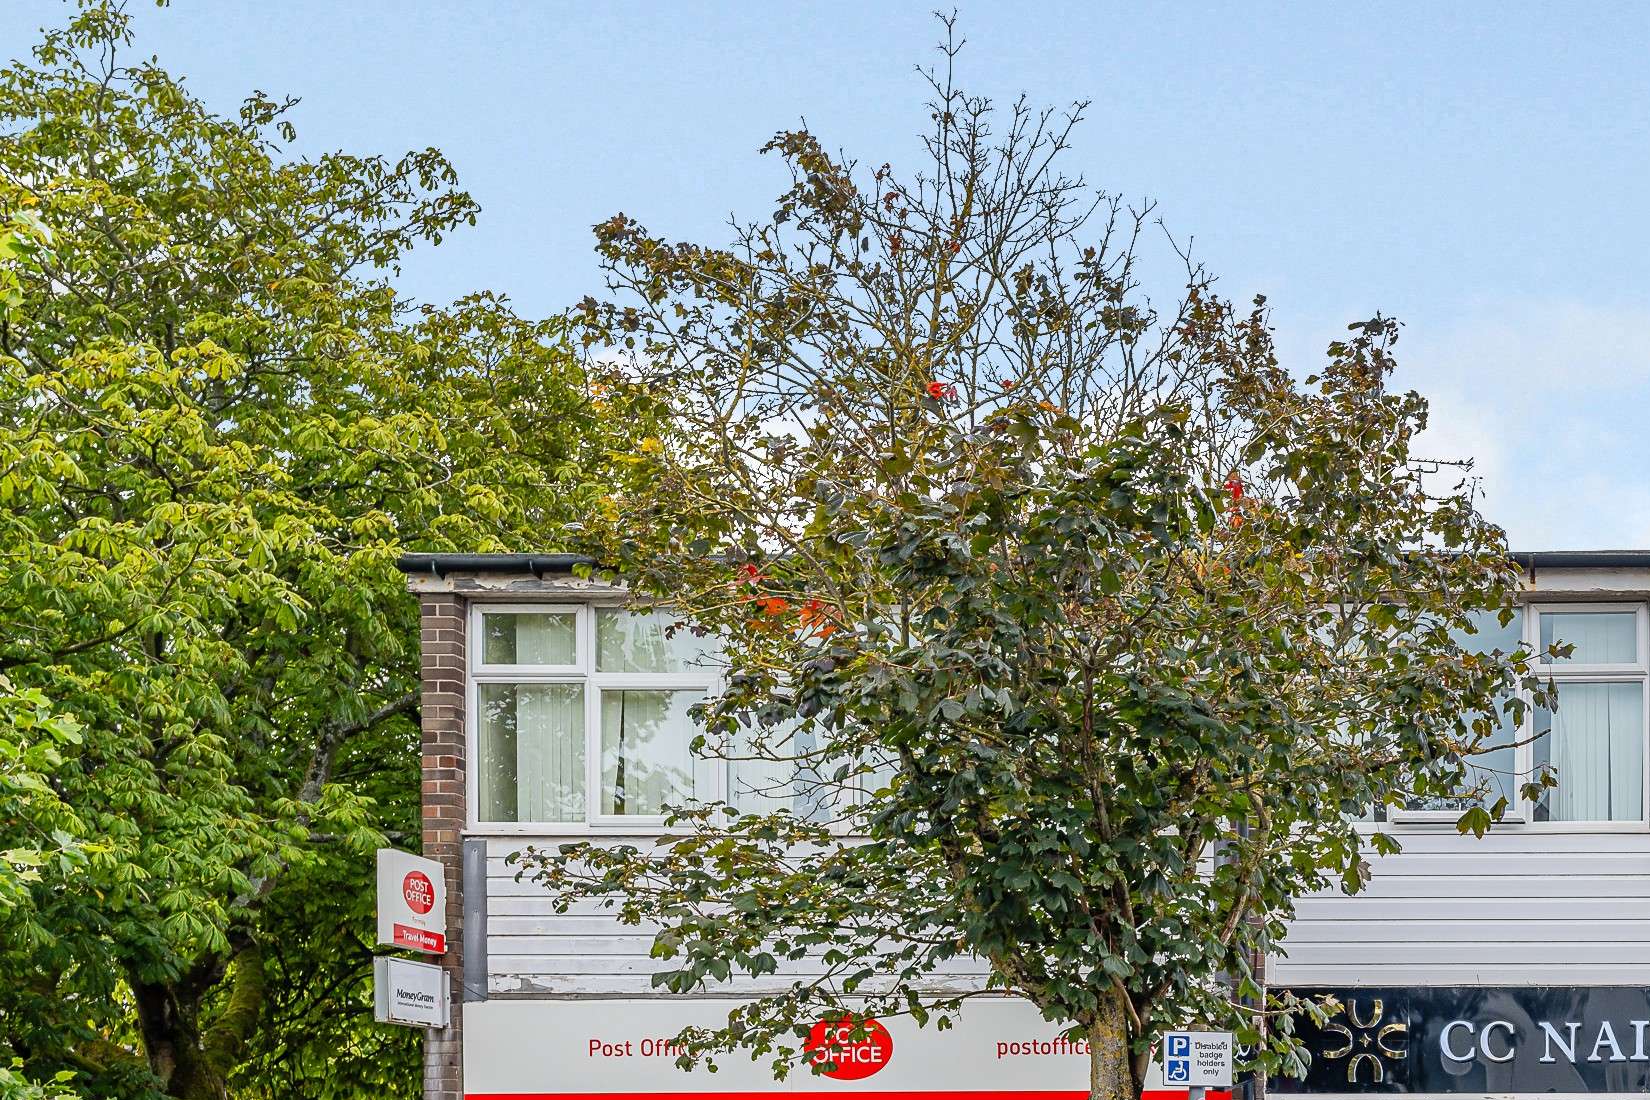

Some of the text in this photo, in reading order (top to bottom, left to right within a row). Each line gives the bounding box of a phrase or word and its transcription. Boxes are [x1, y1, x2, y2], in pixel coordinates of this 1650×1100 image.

[409, 878, 429, 893] POST
[405, 890, 431, 906] OFFICE
[402, 930, 437, 948] Travel Money
[396, 988, 434, 1002] MoneyGram
[589, 1039, 633, 1057] Post
[1195, 1041, 1228, 1050] Disabled
[1439, 1020, 1516, 1062] CC
[813, 1046, 883, 1063] OFFICE
[1200, 1051, 1224, 1060] badge
[1203, 1068, 1220, 1076] only
